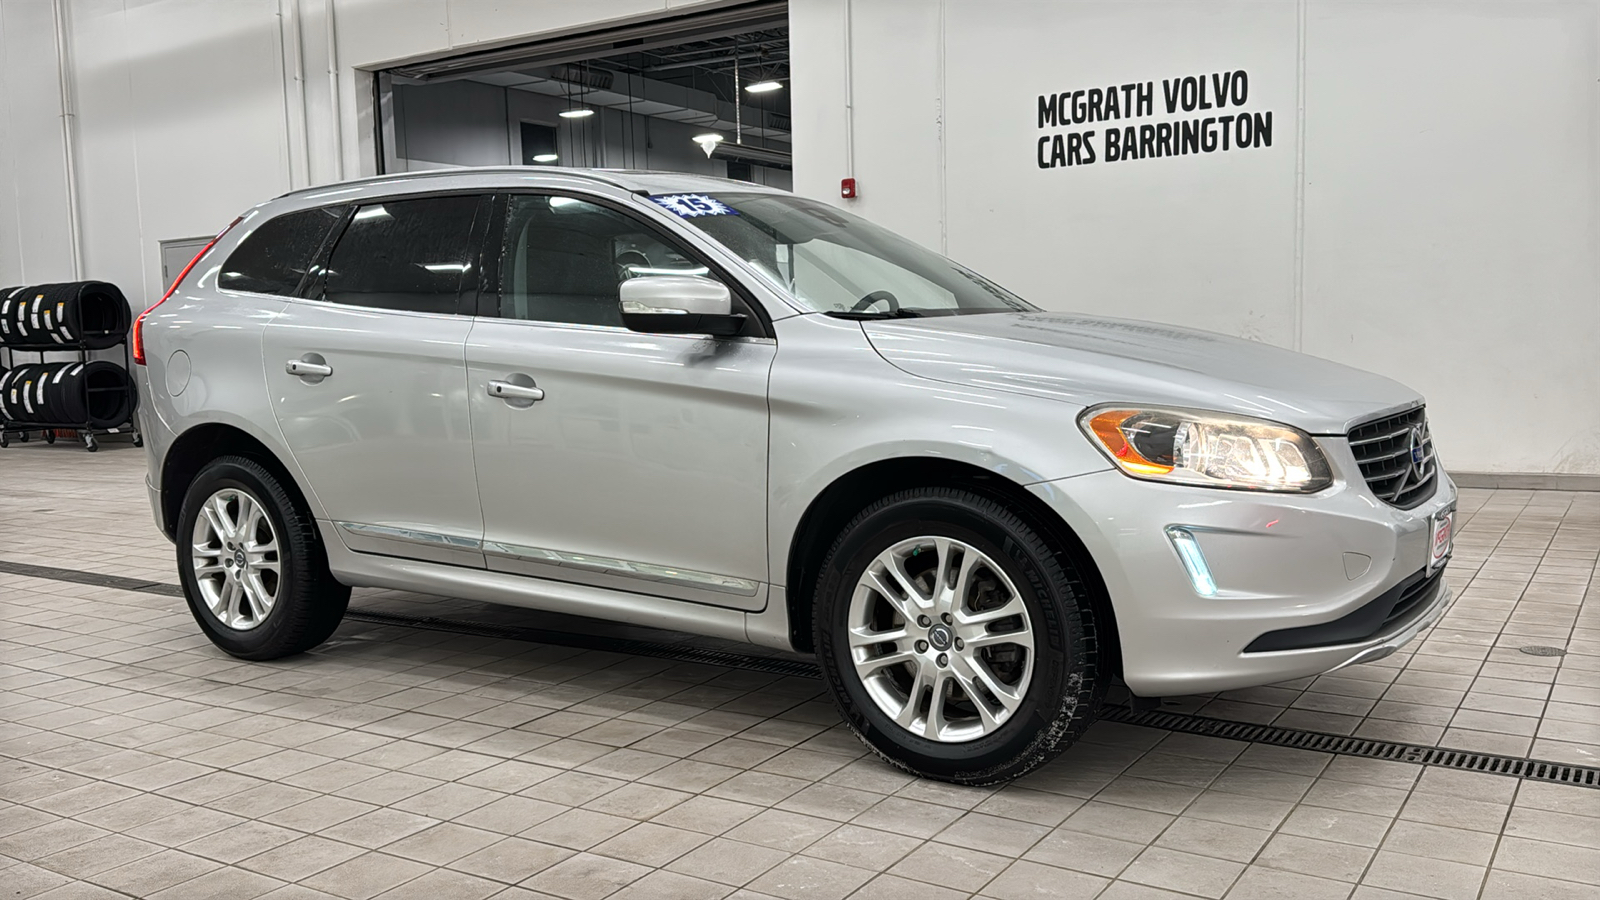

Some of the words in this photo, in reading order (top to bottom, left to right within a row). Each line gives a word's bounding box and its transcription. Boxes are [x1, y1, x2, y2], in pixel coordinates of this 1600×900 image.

[1038, 82, 1153, 128] MCGRATH
[1163, 70, 1248, 114] VOLVO
[1038, 131, 1096, 169] CARS
[1105, 112, 1273, 162] BARRINGTON
[676, 198, 713, 212] 15
[1026, 570, 1060, 647] MICHELIN
